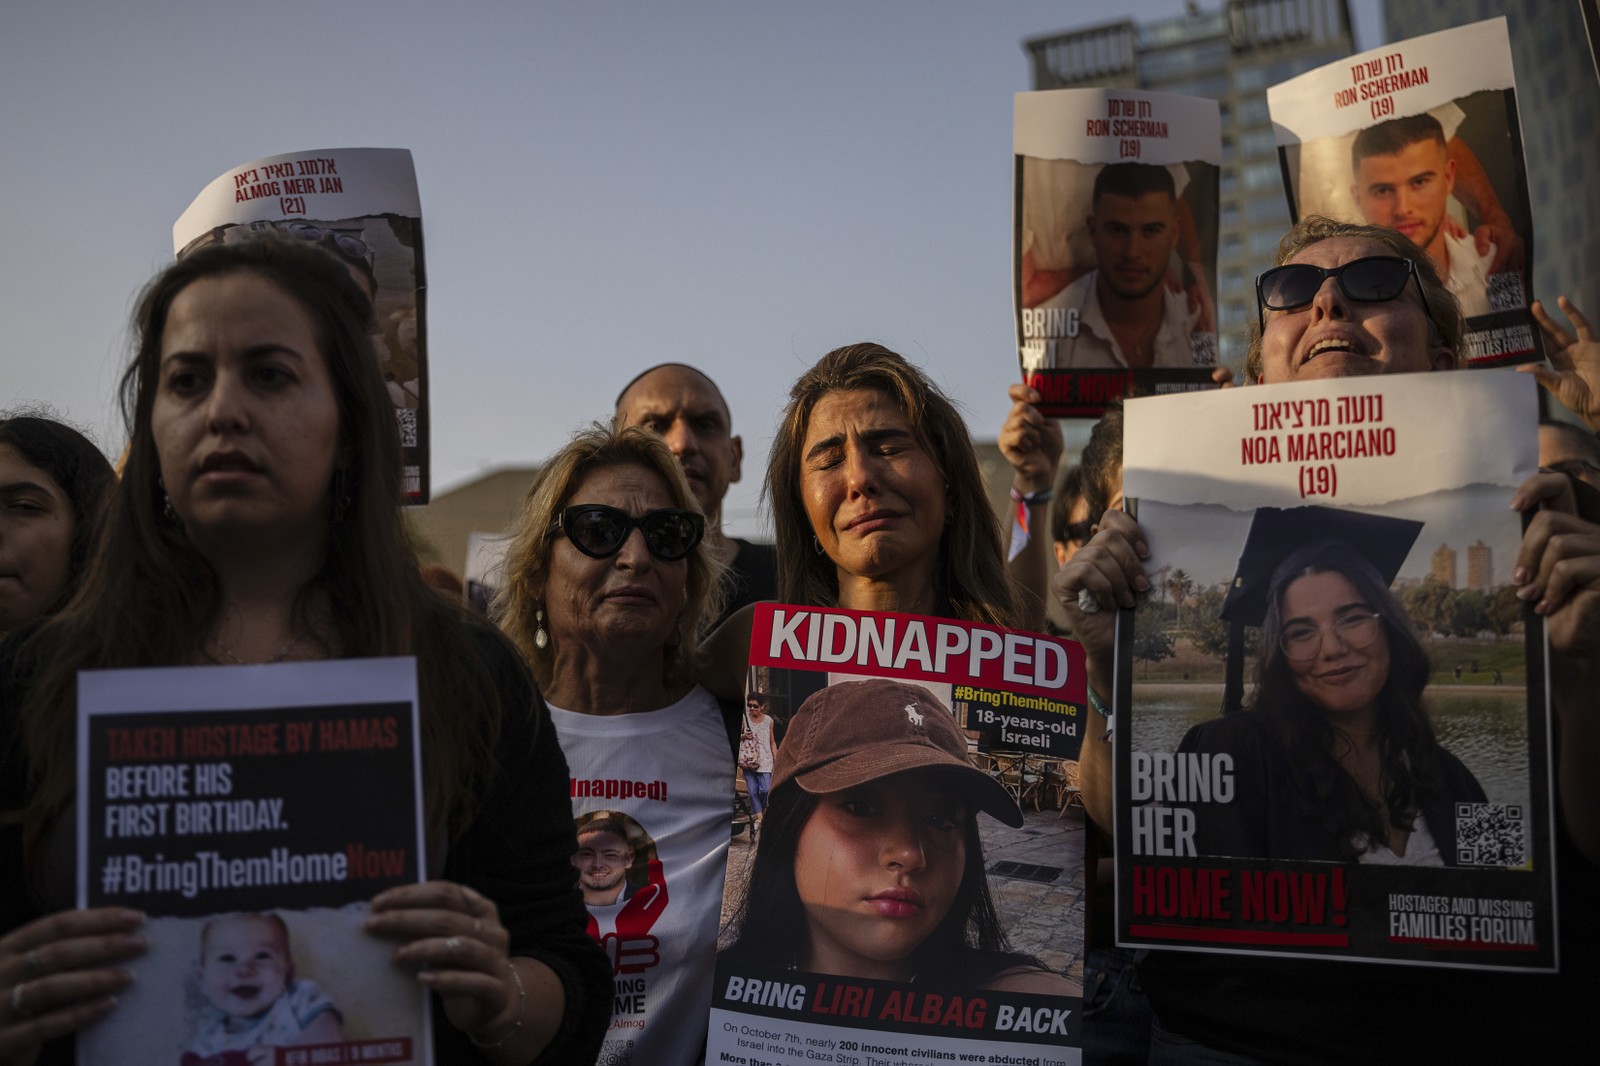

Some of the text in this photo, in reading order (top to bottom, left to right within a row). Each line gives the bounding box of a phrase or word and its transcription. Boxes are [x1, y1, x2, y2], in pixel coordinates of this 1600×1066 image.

[1350, 53, 1404, 84] רון שרמן
[1334, 66, 1429, 109] RON SCHERMAN
[1108, 99, 1152, 119] רון שרמן
[1370, 95, 1395, 120] (19)
[1086, 119, 1168, 139] RON SCHERMAN
[1119, 139, 1140, 159] (19)
[260, 162, 295, 180] מאיר
[296, 158, 338, 176] אלמוג
[235, 177, 343, 203] ALMOG MEIR JAN
[280, 196, 306, 216] (21)
[1022, 308, 1080, 339] BRING
[1503, 335, 1535, 355] FORUM
[1252, 394, 1383, 431] נועה מרציאנו
[1241, 427, 1396, 465] NOA MARCIANO
[1299, 463, 1337, 499] (19)
[769, 609, 1069, 689] KIDNAPPED
[954, 685, 1077, 717] #BringThemHome
[106, 716, 398, 760] TAKEN HOSTAGE BY HAMAS
[976, 708, 1077, 737] 18-years-old
[1001, 728, 1051, 749] Israeli
[105, 762, 233, 799] BEFORE HIS
[1130, 751, 1235, 804] BRING
[105, 798, 289, 838] FIRST BIRTHDAY.
[1131, 806, 1198, 857] HER
[102, 843, 405, 899] #BringThemHomeNow
[1132, 863, 1348, 927] HOME NOW!
[1388, 894, 1534, 919] HOSTAGES AND MISSING
[1390, 911, 1535, 945] FAMILIES FORUM
[615, 979, 646, 994] ING
[614, 994, 646, 1015] ME
[724, 975, 1072, 1035] BRING LIRI ALBAG BACK
[720, 1052, 746, 1065] More
[723, 1022, 738, 1033] On
[741, 1025, 781, 1041] October
[785, 1033, 802, 1045] 7th,
[806, 1037, 836, 1051] nearly
[839, 1040, 858, 1051] 200
[861, 1042, 908, 1056] innocent
[911, 1048, 955, 1061] civilians
[959, 1052, 985, 1063] were
[988, 1054, 1039, 1066] abducted
[737, 1038, 764, 1051] Israel
[768, 1044, 785, 1055] into
[788, 1046, 804, 1058] the
[806, 1050, 832, 1063] Gaza
[836, 1053, 861, 1066] Strip.
